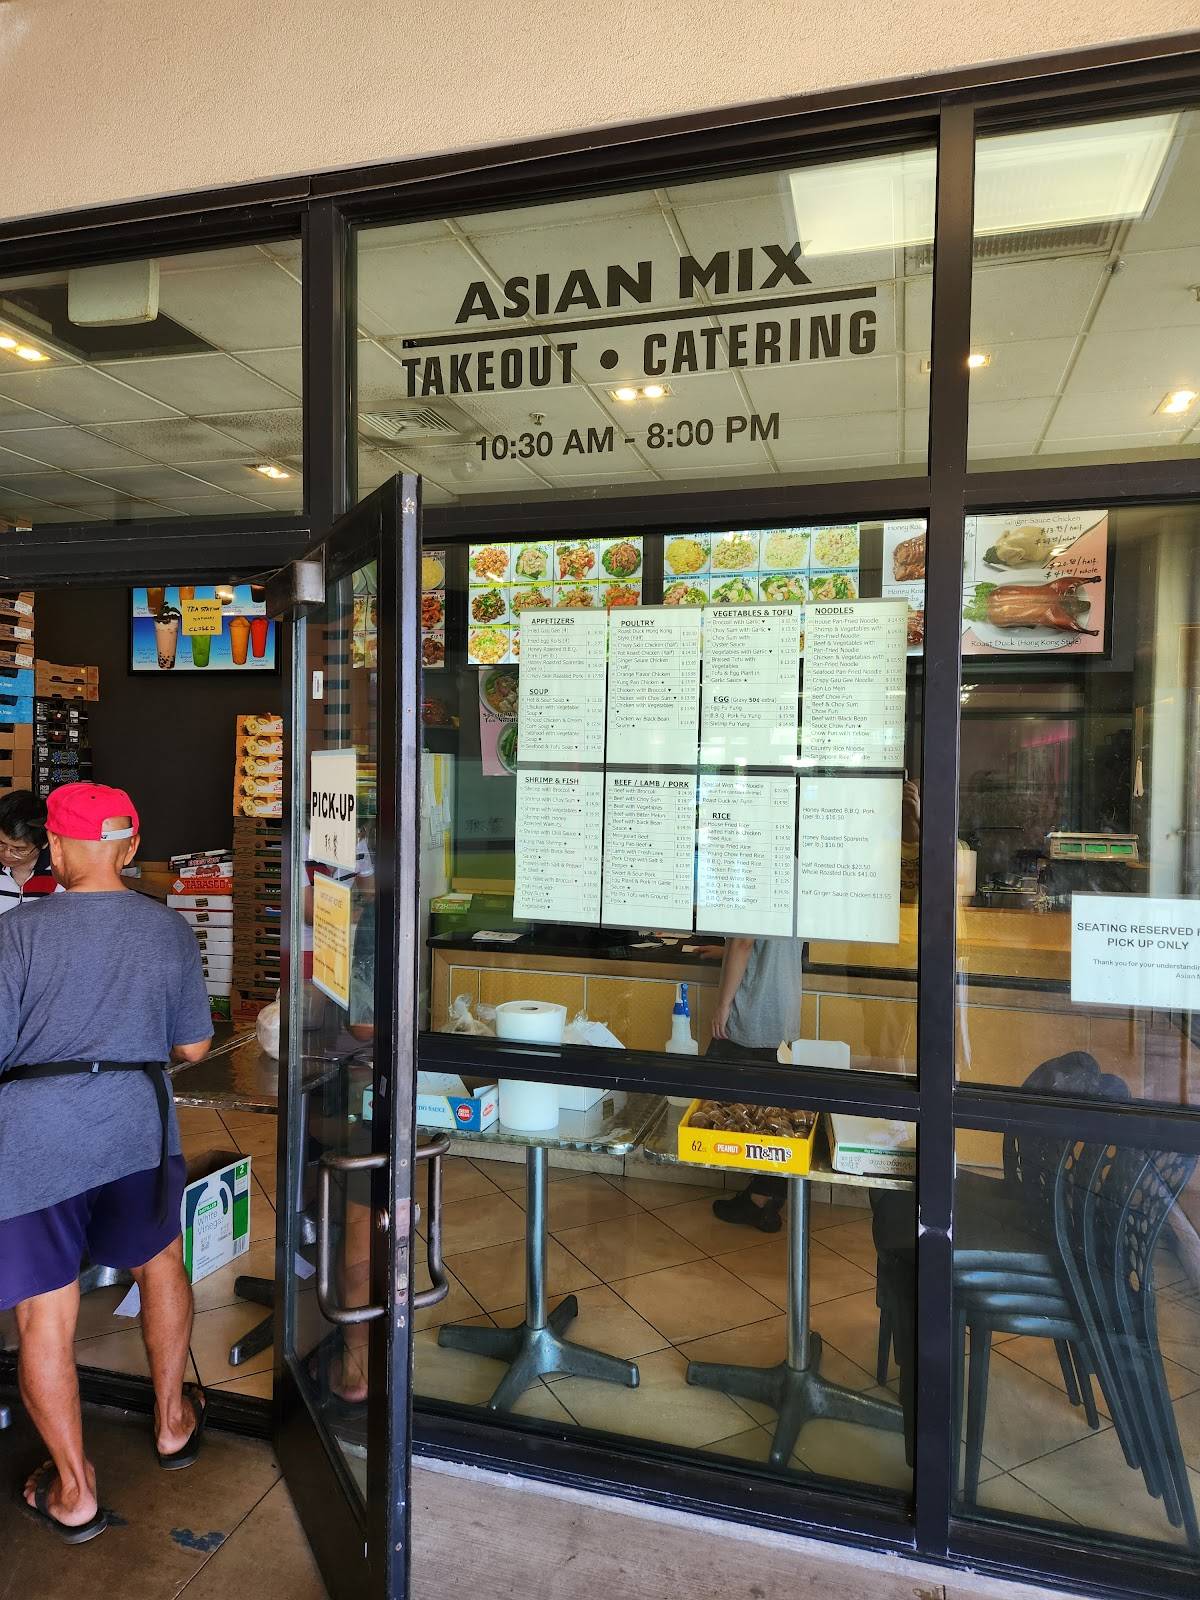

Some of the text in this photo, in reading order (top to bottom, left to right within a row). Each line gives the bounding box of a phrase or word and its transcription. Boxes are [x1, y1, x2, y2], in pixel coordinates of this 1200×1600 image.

[455, 240, 813, 324] ASIAN MIX
[402, 310, 877, 398] TAKEOUT CATERING
[475, 431, 554, 461] 10:30
[562, 426, 615, 456] AM
[647, 418, 713, 450] 8:00
[726, 413, 780, 442] PM
[1052, 515, 1081, 523] Chicken
[531, 617, 575, 625] APPETIZERS
[994, 639, 1014, 647] Duck
[312, 791, 355, 822] PICK-UP
[185, 880, 226, 889] TABASCO
[1077, 922, 1127, 933] SEATING
[1130, 924, 1194, 936] RESERVED
[1107, 938, 1190, 950] PICK UP ONLY
[1093, 958, 1114, 967] Thank
[1114, 961, 1127, 969] you
[1140, 962, 1155, 971] your
[691, 1140, 703, 1152] 62
[717, 1144, 738, 1154] PEANUT
[198, 1210, 218, 1226] White
